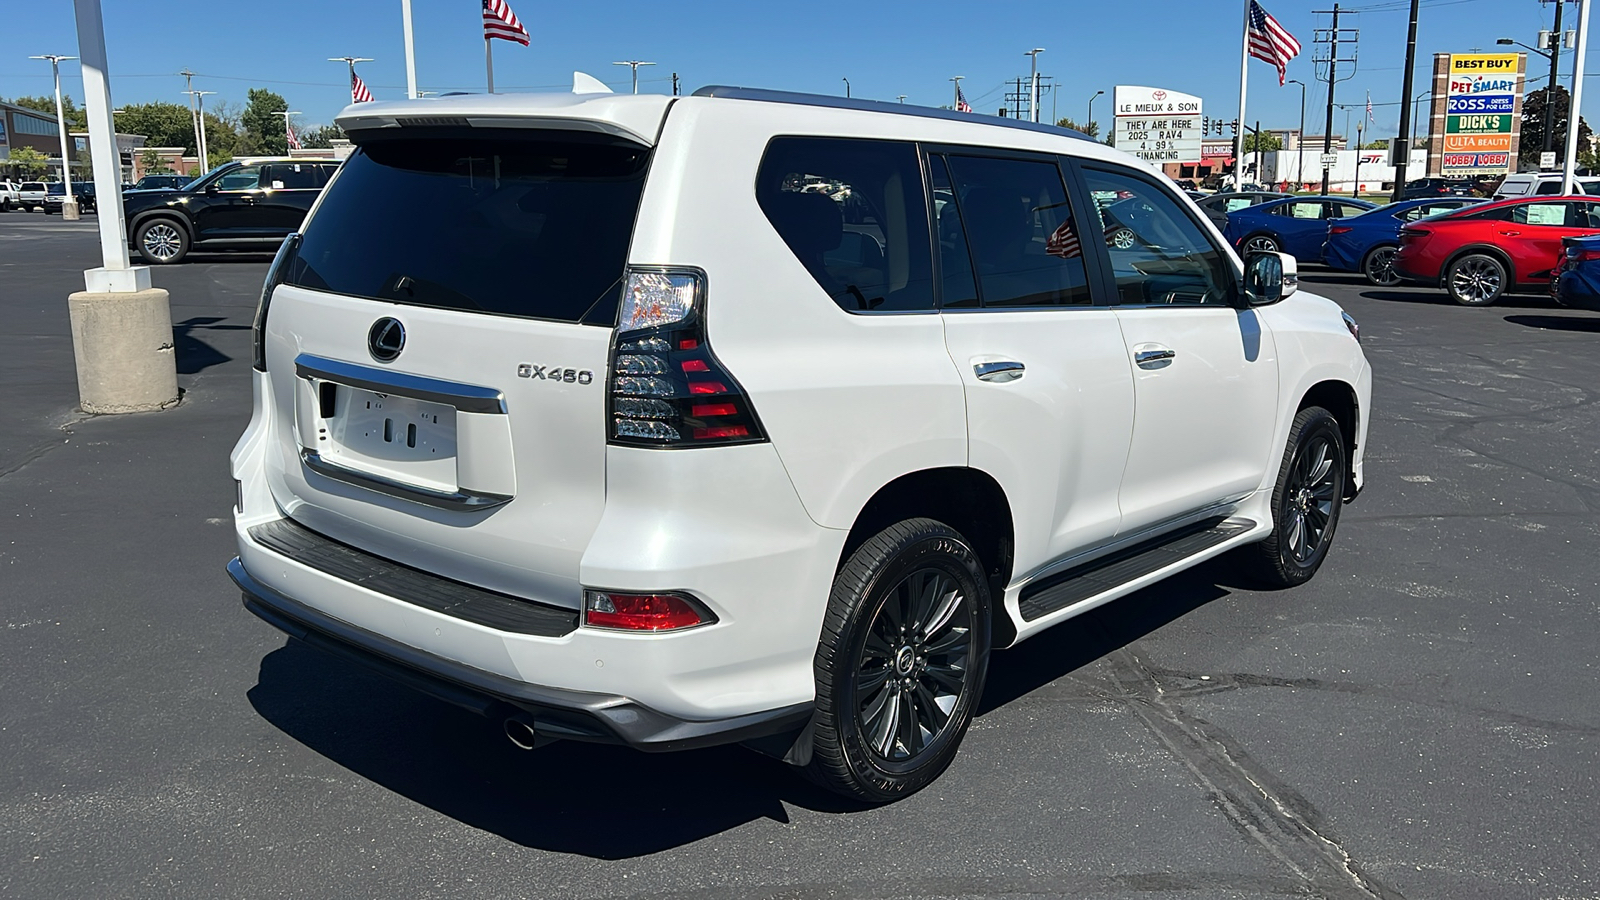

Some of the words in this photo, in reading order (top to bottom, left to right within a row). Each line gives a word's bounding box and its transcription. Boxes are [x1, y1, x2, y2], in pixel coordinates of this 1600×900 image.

[1455, 60, 1485, 68] BEST
[1486, 59, 1513, 68] BUY
[1451, 80, 1514, 93] PETSMART
[1120, 104, 1131, 112] LE
[1135, 103, 1163, 112] MIEUX
[1167, 103, 1173, 111] &
[1178, 103, 1198, 111] SON
[1448, 99, 1486, 110] ROSS
[1126, 121, 1147, 130] THEY
[1151, 120, 1167, 129] ARE
[1171, 120, 1192, 129] HERE
[1459, 115, 1500, 129] DICK'S
[1128, 131, 1148, 140] 2025
[1159, 130, 1182, 140] RAV4
[1448, 136, 1475, 148] ULTA
[1477, 138, 1509, 146] BEAUTY
[1202, 146, 1213, 154] OLD
[1444, 154, 1476, 166] HOBBY
[1478, 154, 1508, 166] LOBBY
